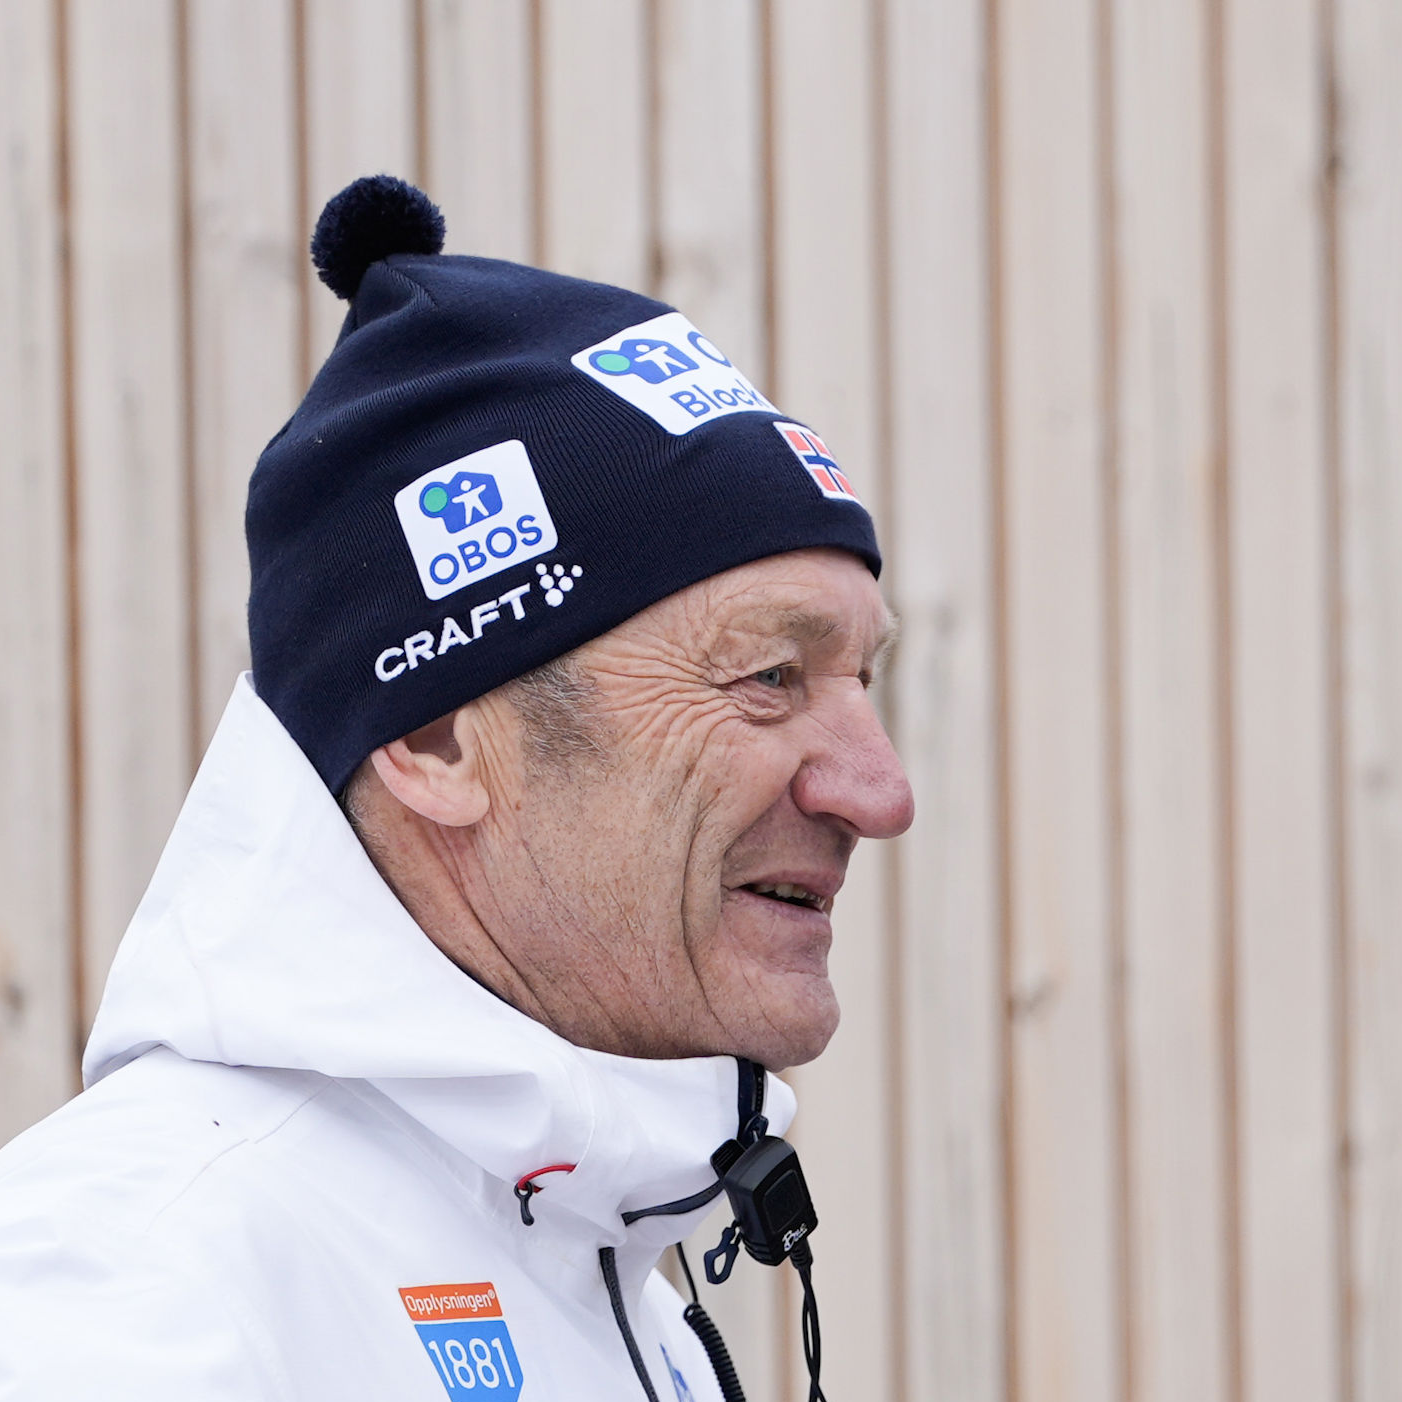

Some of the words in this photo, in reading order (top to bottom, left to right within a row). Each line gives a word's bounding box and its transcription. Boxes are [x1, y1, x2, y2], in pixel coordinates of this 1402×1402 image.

[429, 514, 543, 586] OBOS
[374, 582, 531, 682] CRAFT
[427, 1337, 516, 1390] 1881
